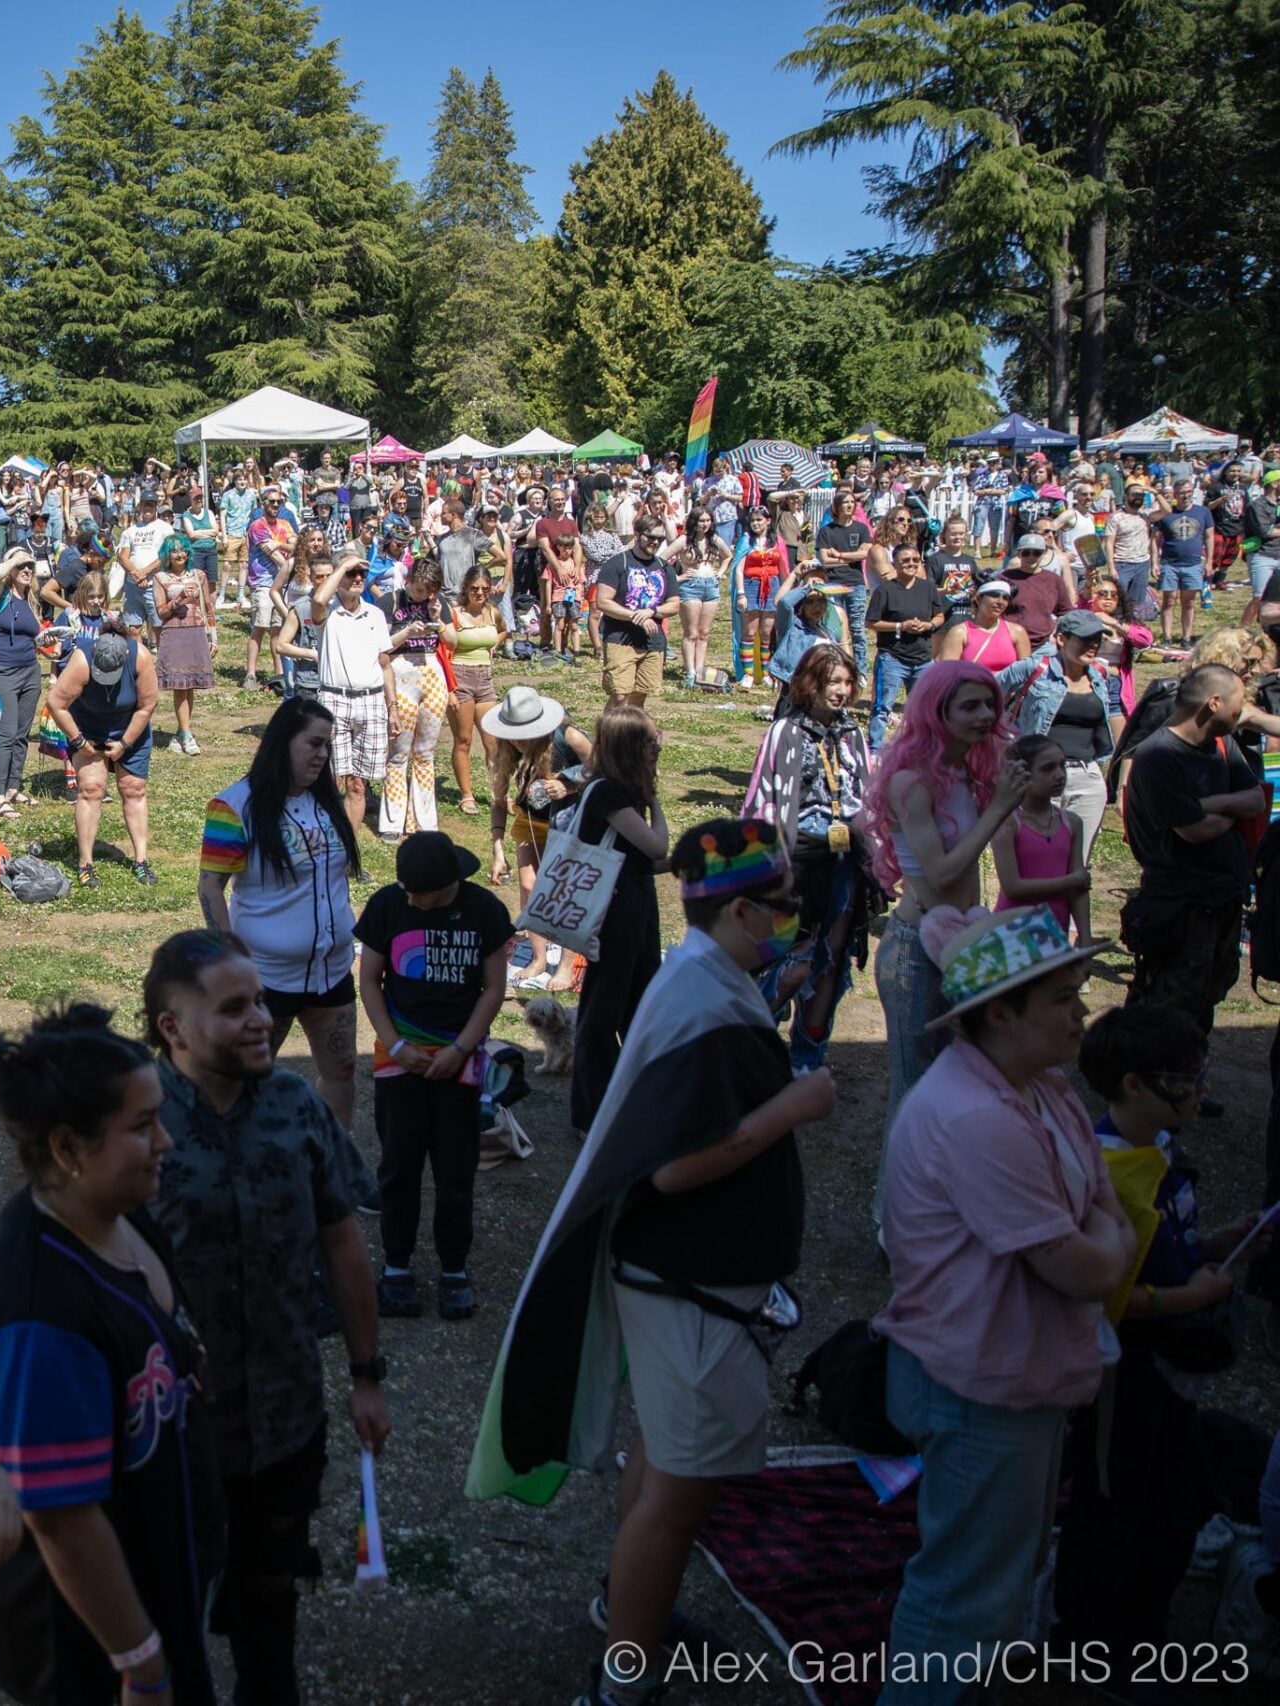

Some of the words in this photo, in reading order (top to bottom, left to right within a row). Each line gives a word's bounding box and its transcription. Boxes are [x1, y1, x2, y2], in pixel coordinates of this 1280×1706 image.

[544, 854, 602, 891] LOVE
[550, 880, 576, 901] IS
[528, 892, 587, 930] LOVE
[425, 929, 448, 945] IT'S
[453, 930, 477, 946] NOT
[426, 946, 480, 966] FUCKING
[426, 965, 466, 984] PHASE
